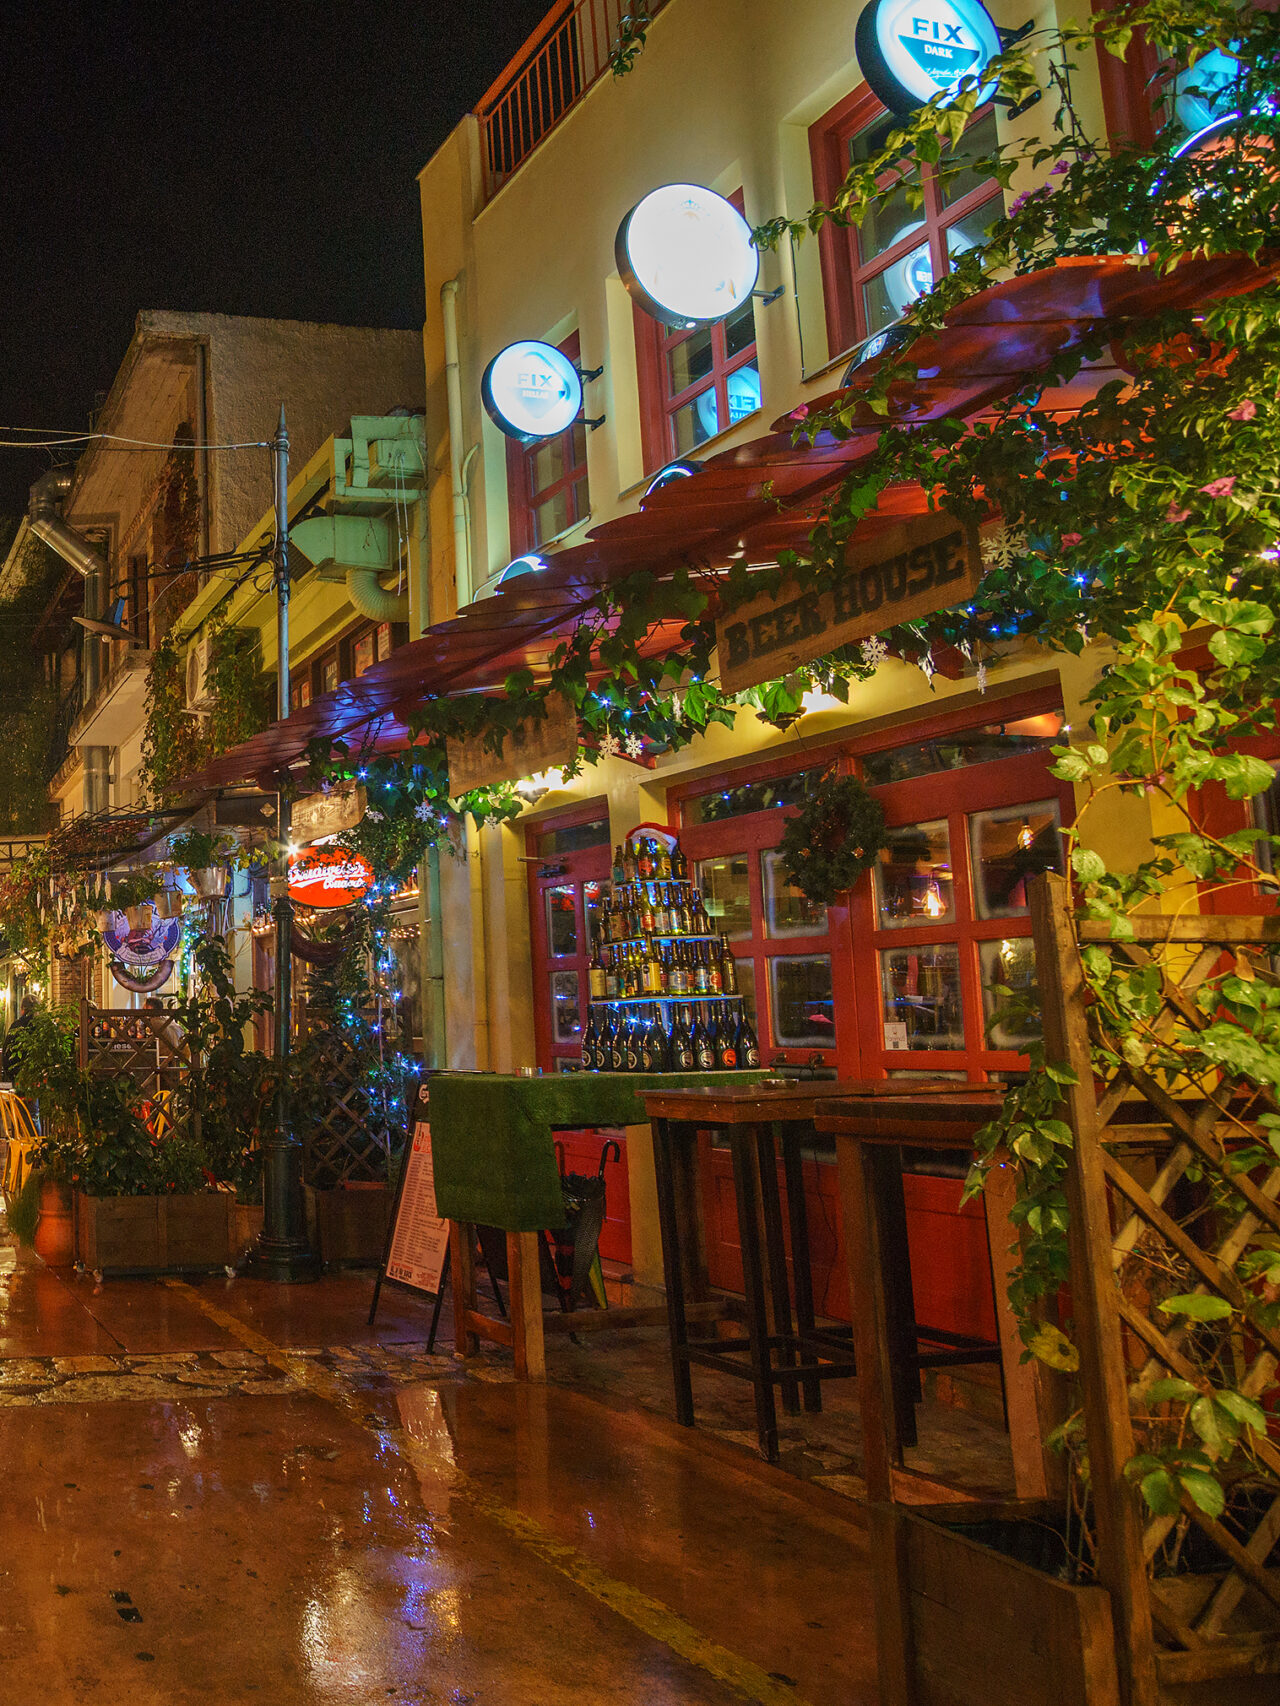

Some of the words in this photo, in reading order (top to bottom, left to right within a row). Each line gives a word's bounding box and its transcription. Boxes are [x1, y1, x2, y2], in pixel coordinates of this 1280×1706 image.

[912, 17, 965, 45] FIX
[924, 44, 953, 59] DARK
[517, 373, 552, 387] FIX
[724, 592, 827, 670] BEER
[833, 530, 966, 625] HOUSE
